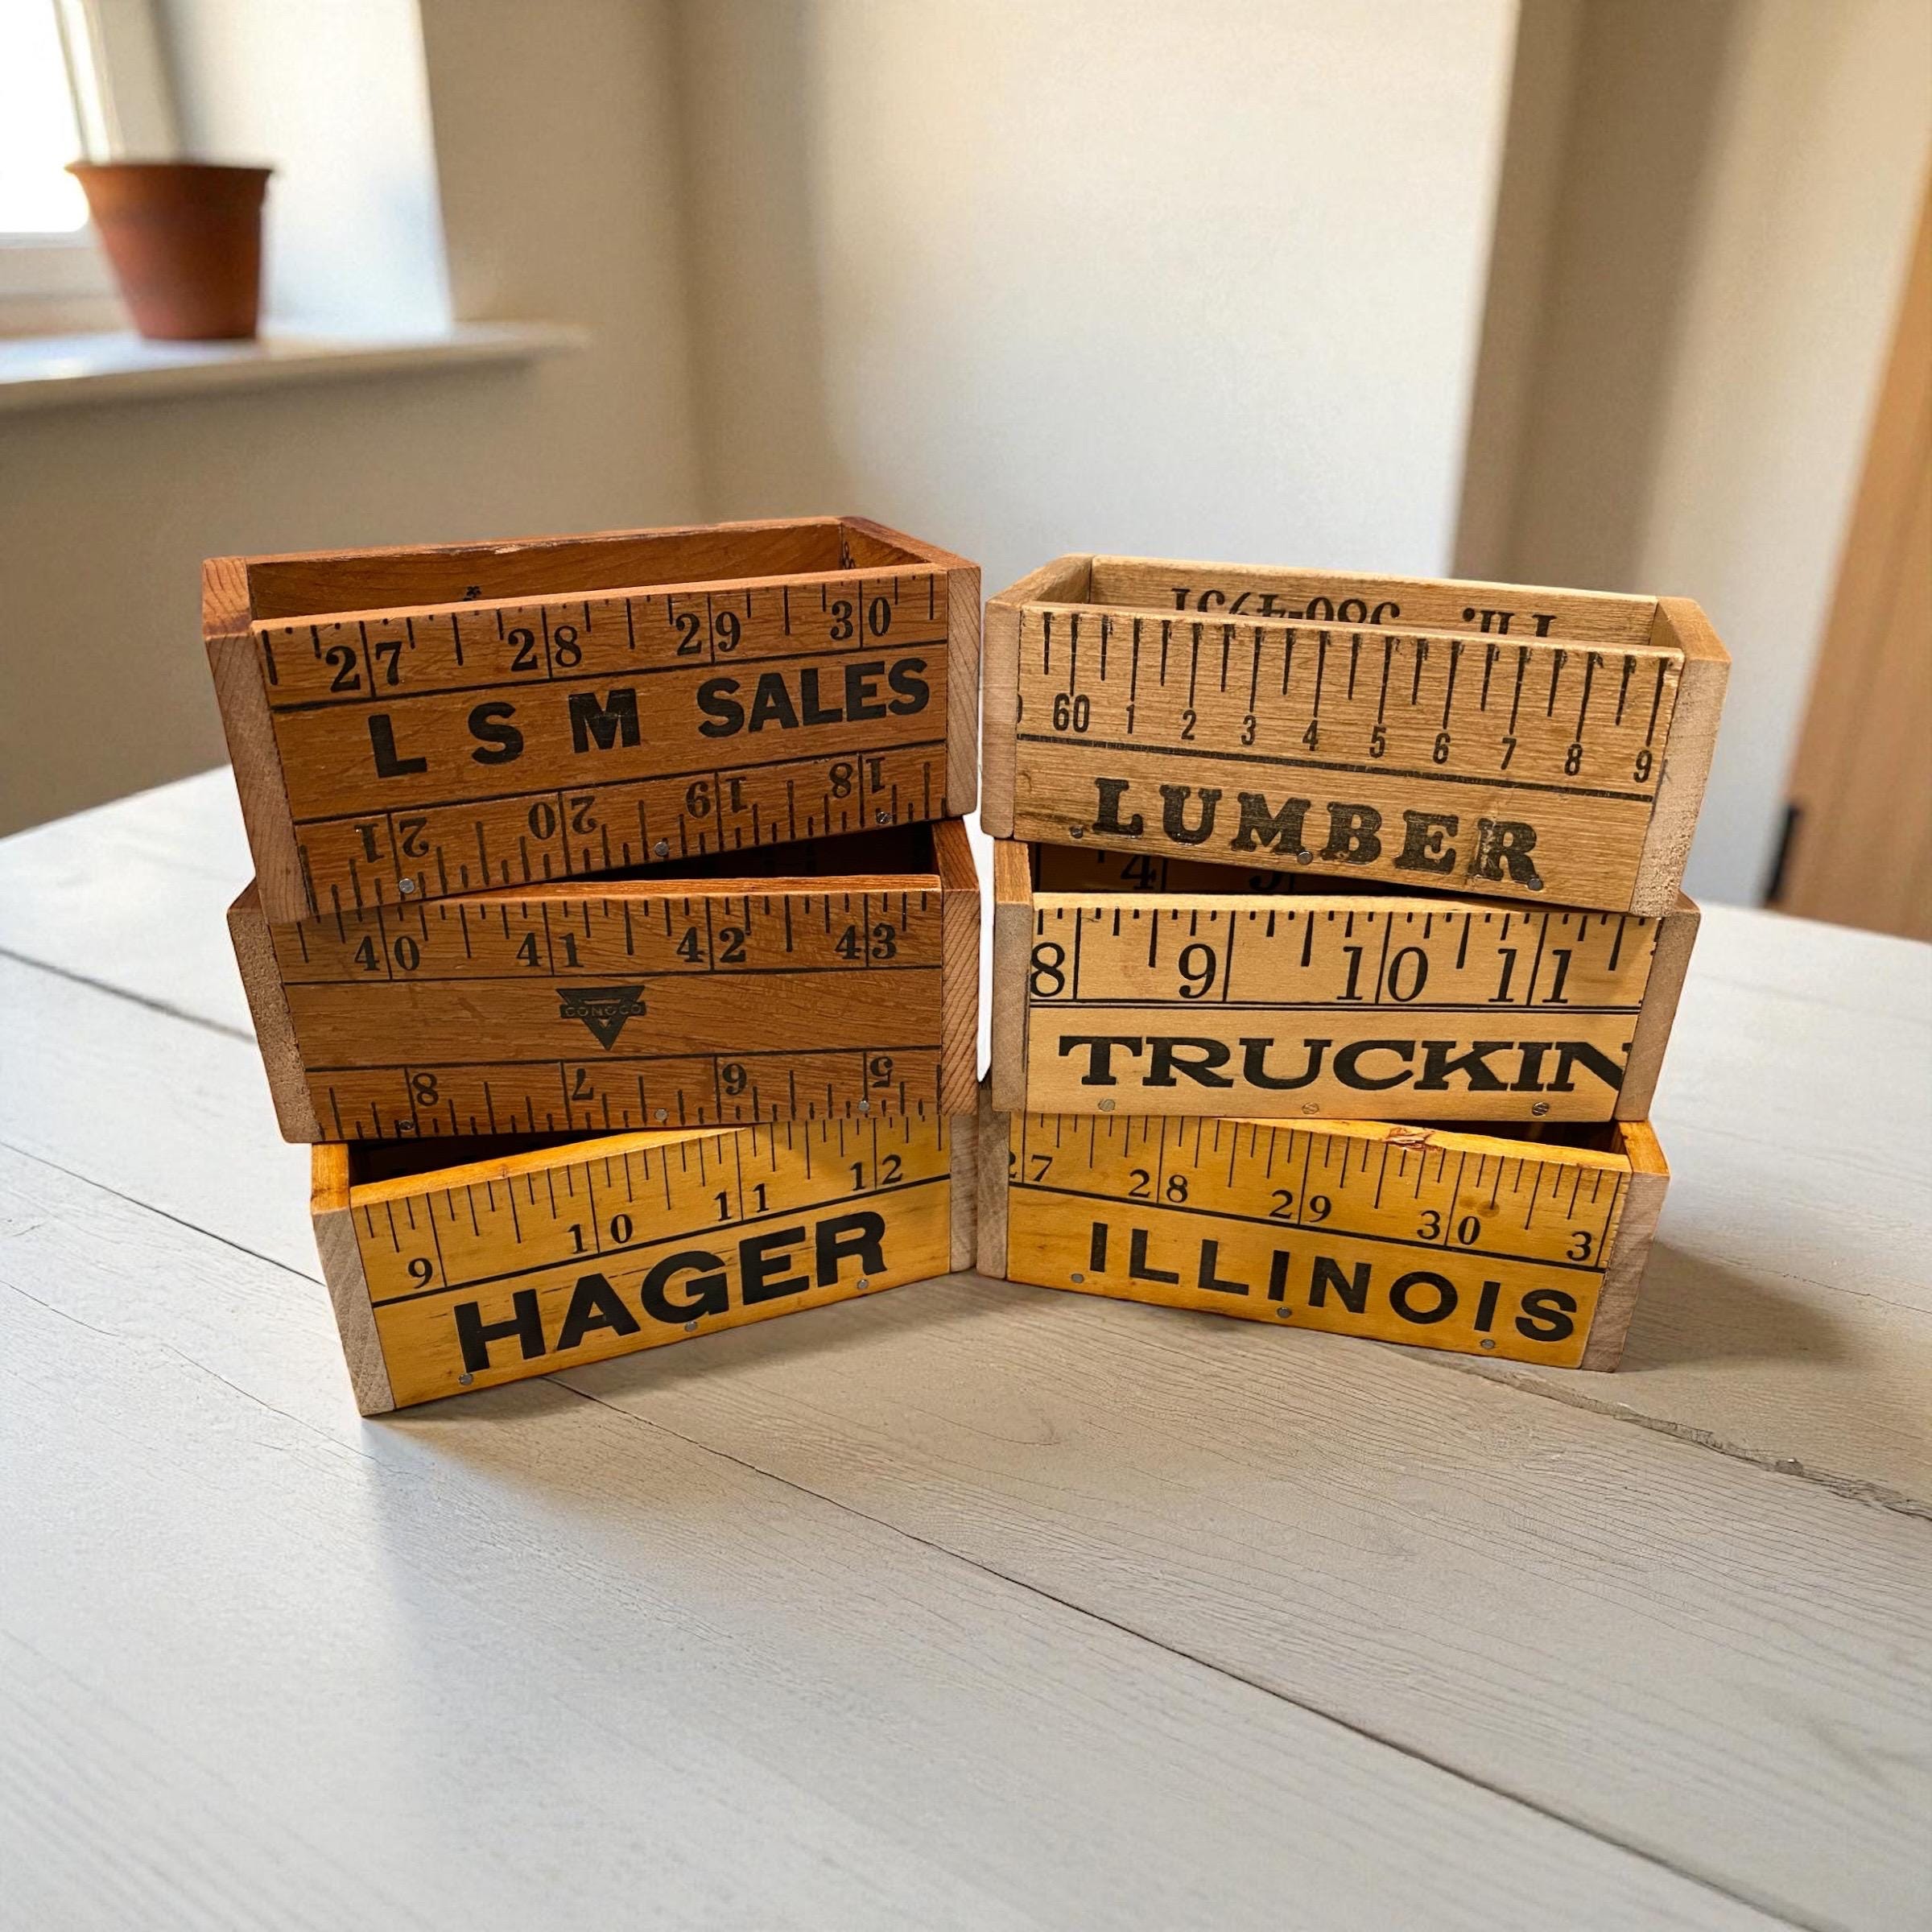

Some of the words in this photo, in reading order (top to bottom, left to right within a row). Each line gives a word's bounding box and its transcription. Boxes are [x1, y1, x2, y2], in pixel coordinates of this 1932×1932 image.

[325, 641, 402, 692] 27
[508, 625, 582, 671] 28
[675, 611, 741, 656] 29
[830, 597, 891, 640] 30
[368, 714, 427, 778] L
[468, 701, 524, 765] S
[568, 688, 641, 753] M
[696, 658, 930, 738] SALES
[1053, 693, 1090, 733] 60
[1126, 704, 1136, 734] 1
[1180, 709, 1197, 741] 2
[1241, 715, 1257, 746] 3
[1302, 720, 1319, 751] 4
[1369, 726, 1387, 758] 5
[1432, 733, 1451, 764] 6
[1501, 738, 1517, 770] 7
[1564, 743, 1583, 776] 8
[1633, 749, 1653, 783] 9
[1092, 778, 1541, 886] LUMBER
[354, 935, 420, 972] 40
[516, 932, 584, 968] 41
[676, 927, 747, 964] 42
[835, 923, 897, 960] 43
[1030, 942, 1066, 998] 8
[1178, 943, 1217, 1000] 9
[1336, 946, 1429, 1002] 10
[1488, 947, 1572, 1004] 11
[412, 1072, 439, 1107] 8
[572, 1068, 594, 1101] 7
[869, 1055, 893, 1088] 5
[1059, 1034, 1632, 1092] TRUCKIN
[407, 1257, 433, 1288] 9
[568, 1213, 633, 1254] 10
[714, 1183, 769, 1221] 11
[849, 1154, 902, 1191] 12
[1129, 1169, 1188, 1203] 28
[1269, 1189, 1332, 1223] 29
[1416, 1210, 1481, 1245] 30
[454, 1211, 887, 1373] HAGER
[1089, 1221, 1577, 1342] ILLINOIS
